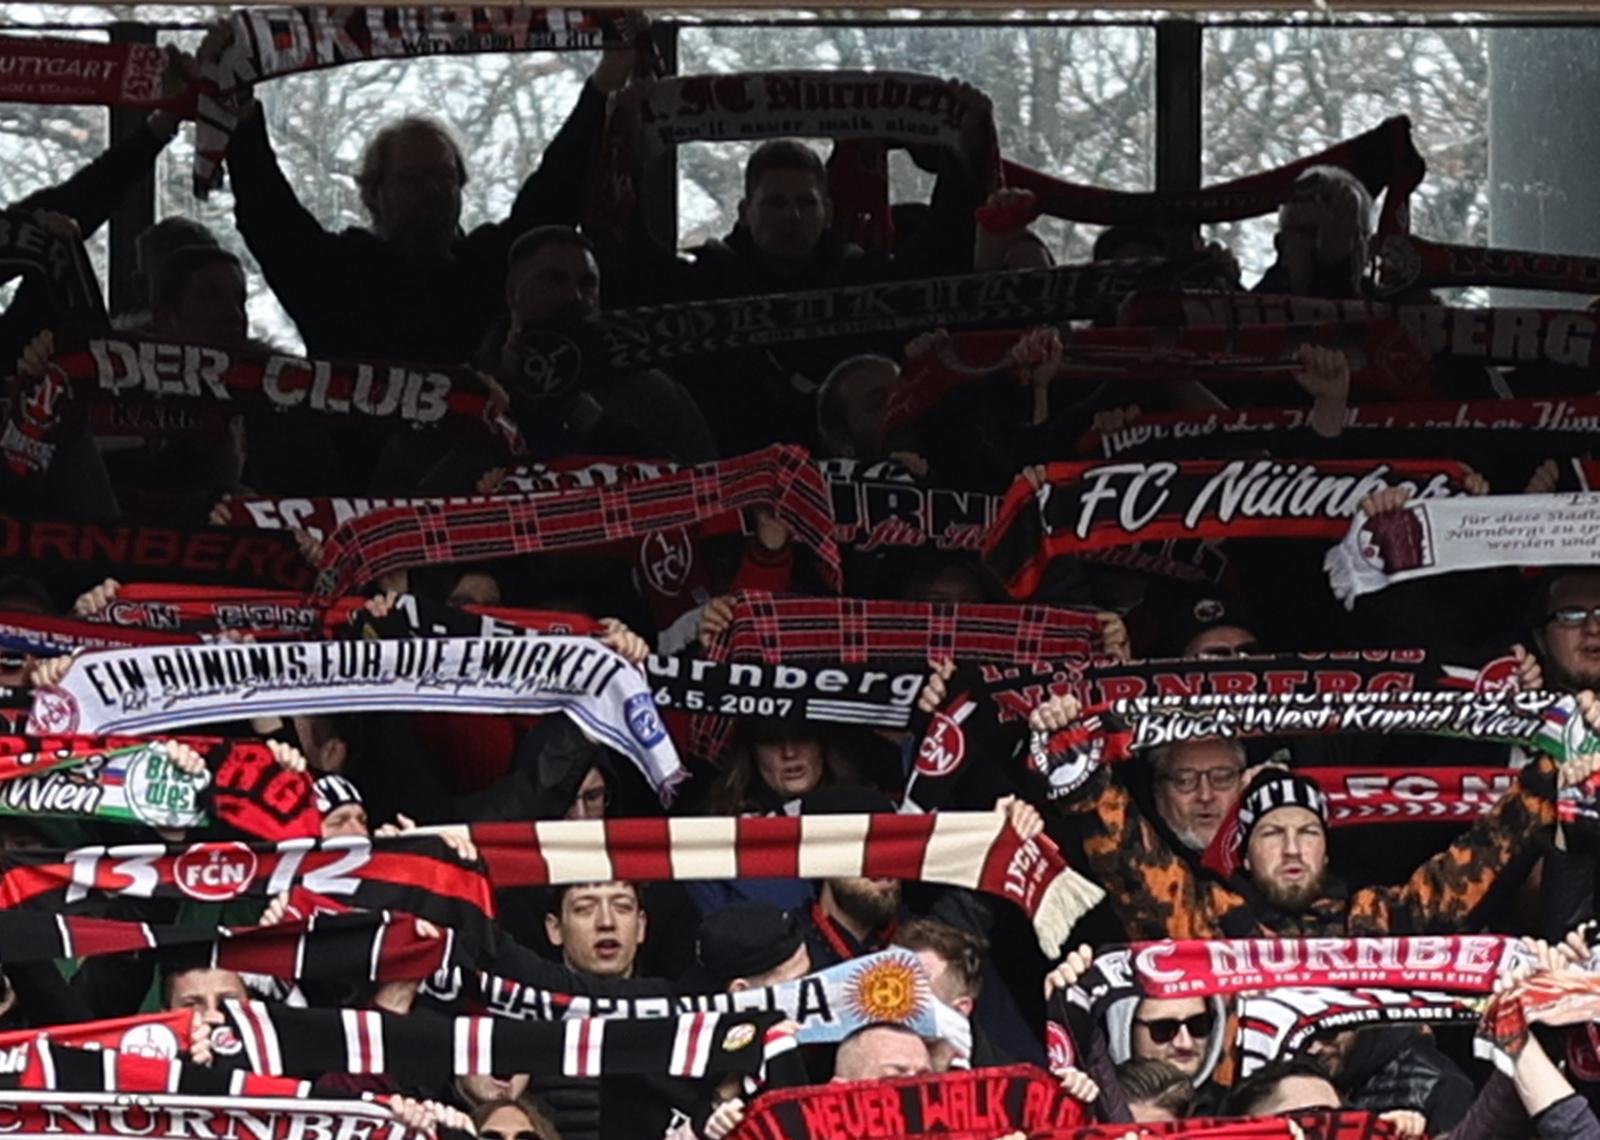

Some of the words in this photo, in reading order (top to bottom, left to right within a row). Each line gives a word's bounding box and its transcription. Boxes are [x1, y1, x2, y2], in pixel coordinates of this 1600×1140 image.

[89, 338, 232, 399] DER
[262, 354, 451, 422] CLUB
[1077, 460, 1179, 539] FC
[1134, 714, 1235, 750] Block
[184, 864, 246, 891] FCN
